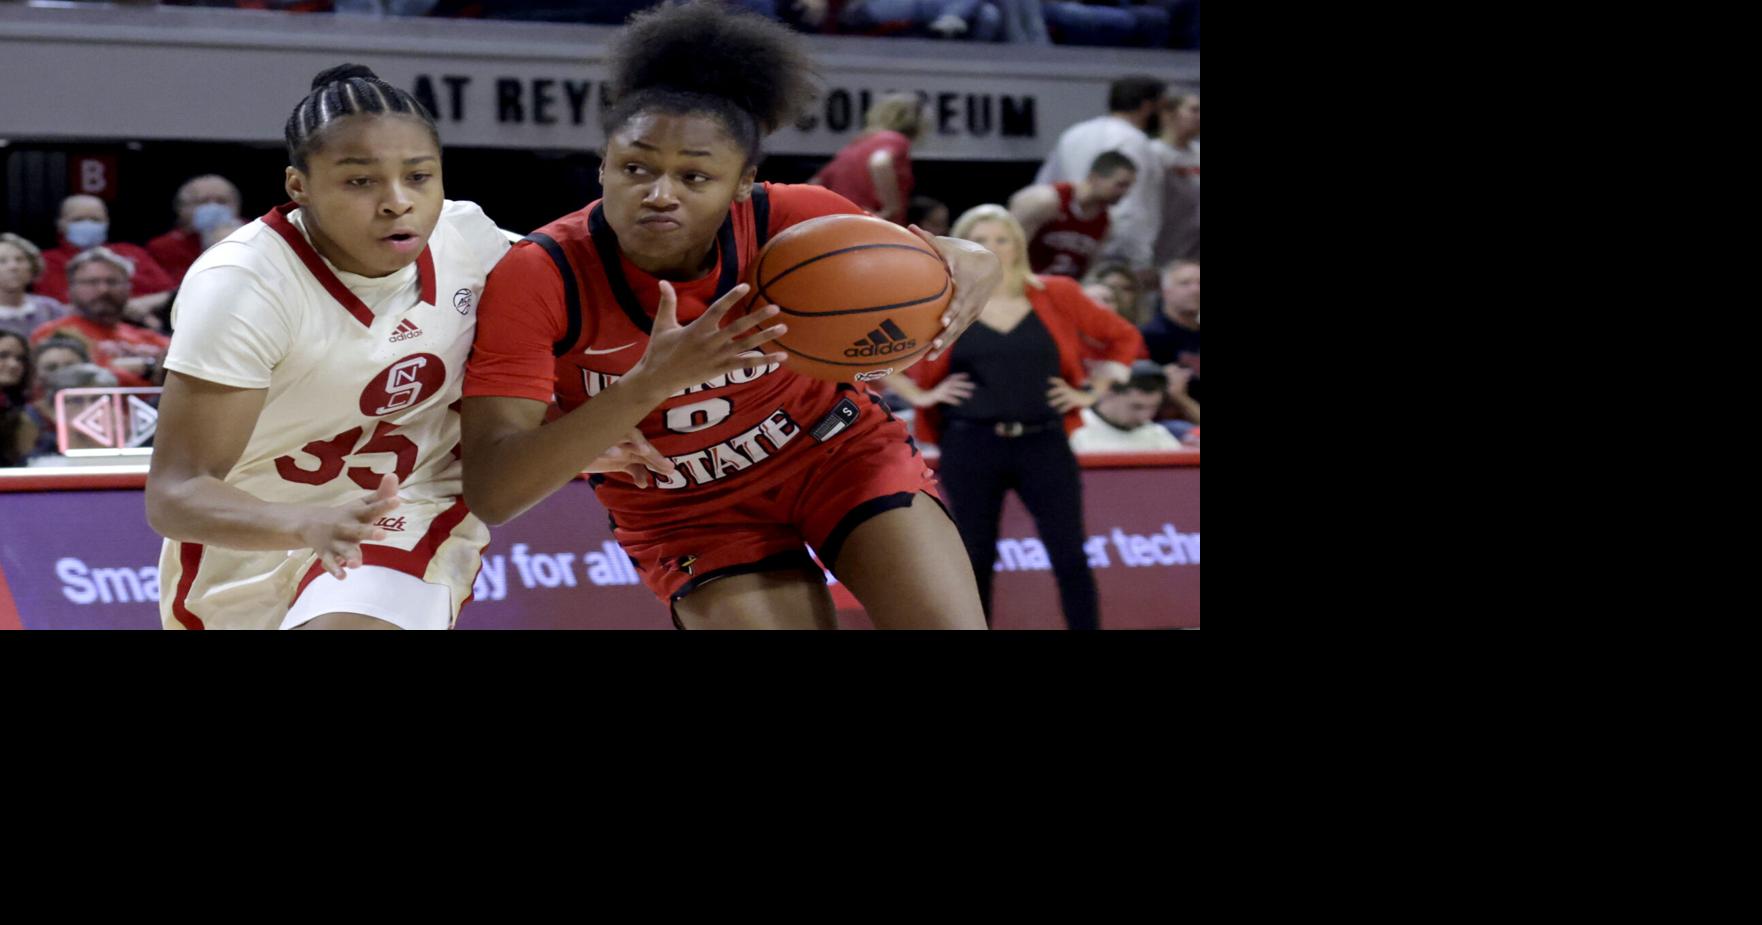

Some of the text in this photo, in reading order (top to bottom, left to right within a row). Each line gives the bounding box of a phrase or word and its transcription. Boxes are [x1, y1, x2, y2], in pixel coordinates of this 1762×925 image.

[414, 75, 471, 122] AT
[496, 78, 606, 126] REY
[80, 159, 107, 192] B
[388, 329, 423, 343] adidas
[843, 339, 916, 357] adidas
[274, 420, 419, 490] 35
[55, 557, 160, 605] Sma
[511, 542, 578, 588] for
[584, 539, 641, 585] all
